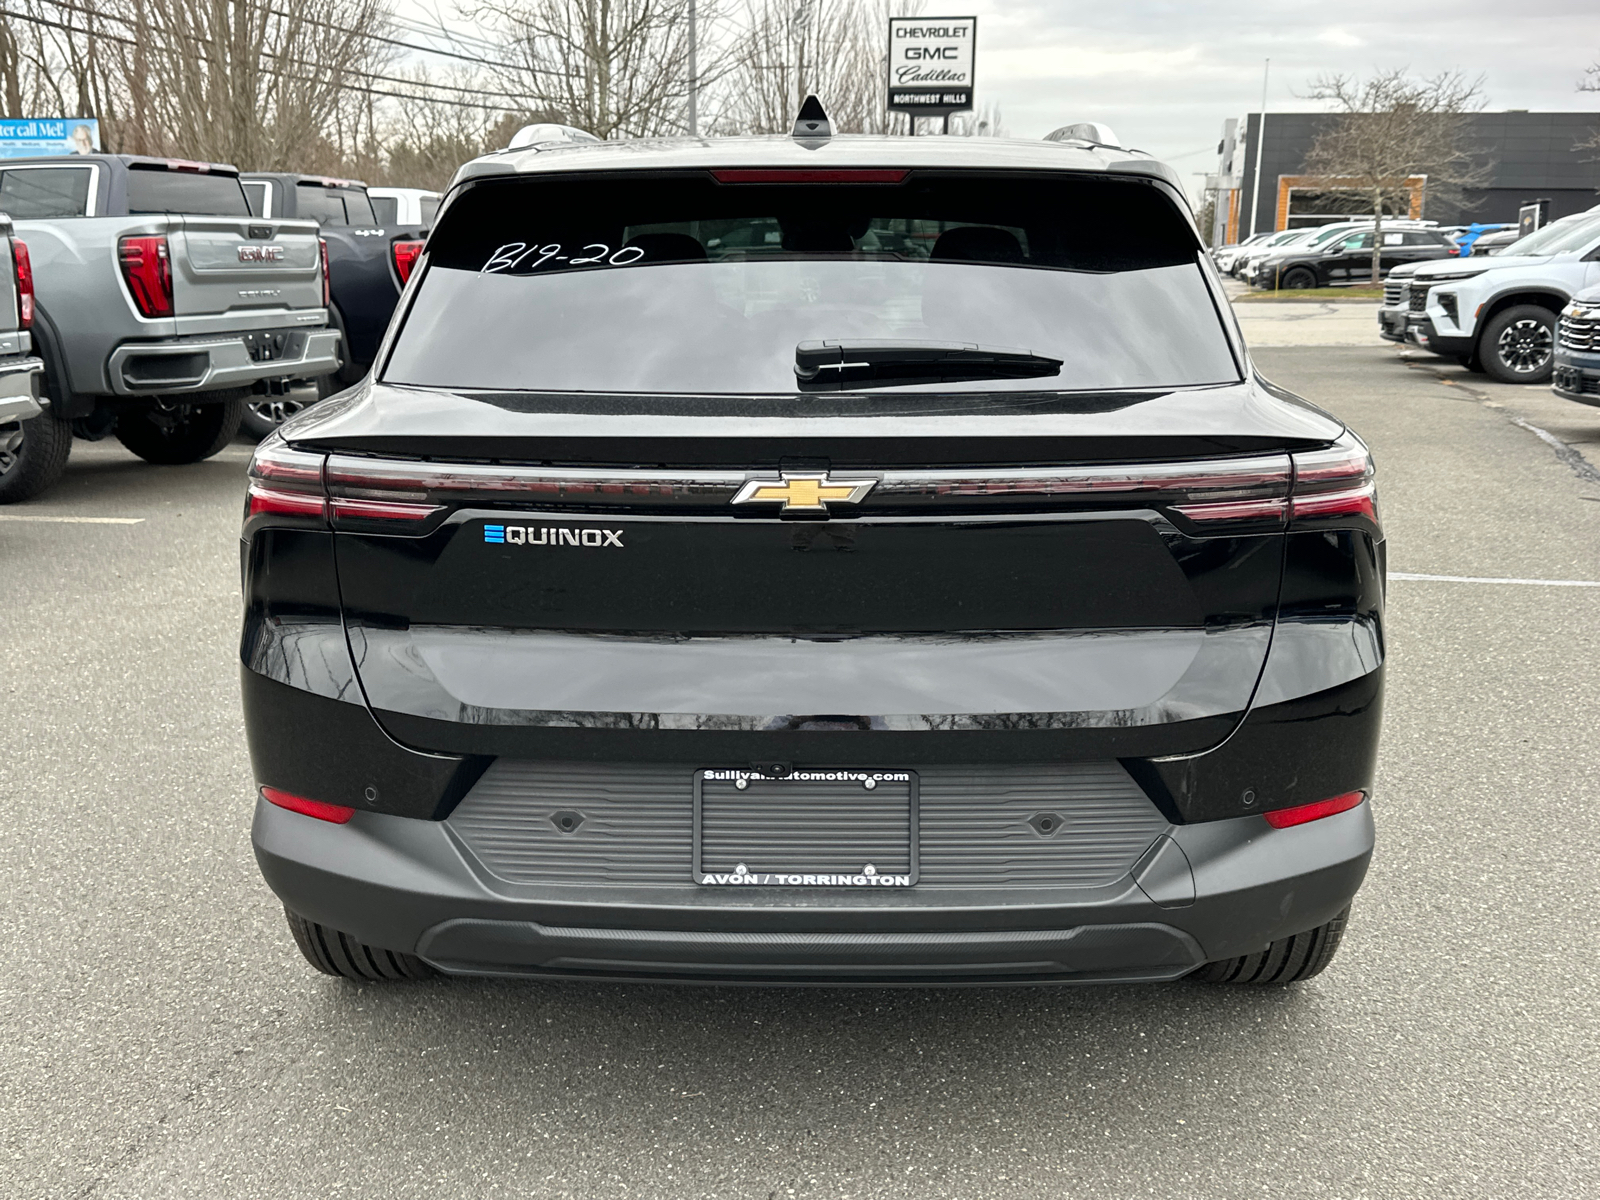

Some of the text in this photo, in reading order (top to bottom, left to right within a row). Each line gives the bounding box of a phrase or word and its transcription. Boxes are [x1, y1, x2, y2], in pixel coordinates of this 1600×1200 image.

[896, 27, 968, 38] CHEVROLET
[905, 47, 958, 60] GMC
[895, 65, 966, 84] Cadillac
[893, 94, 966, 104] NORTHWEST HILLS
[16, 122, 37, 137] call
[39, 122, 65, 137] Mel!
[237, 246, 284, 263] GMC
[484, 524, 624, 547] EQUINOX
[703, 770, 910, 781] Sullivatomotive.com
[701, 874, 910, 886] AVON / TORRINGTON
